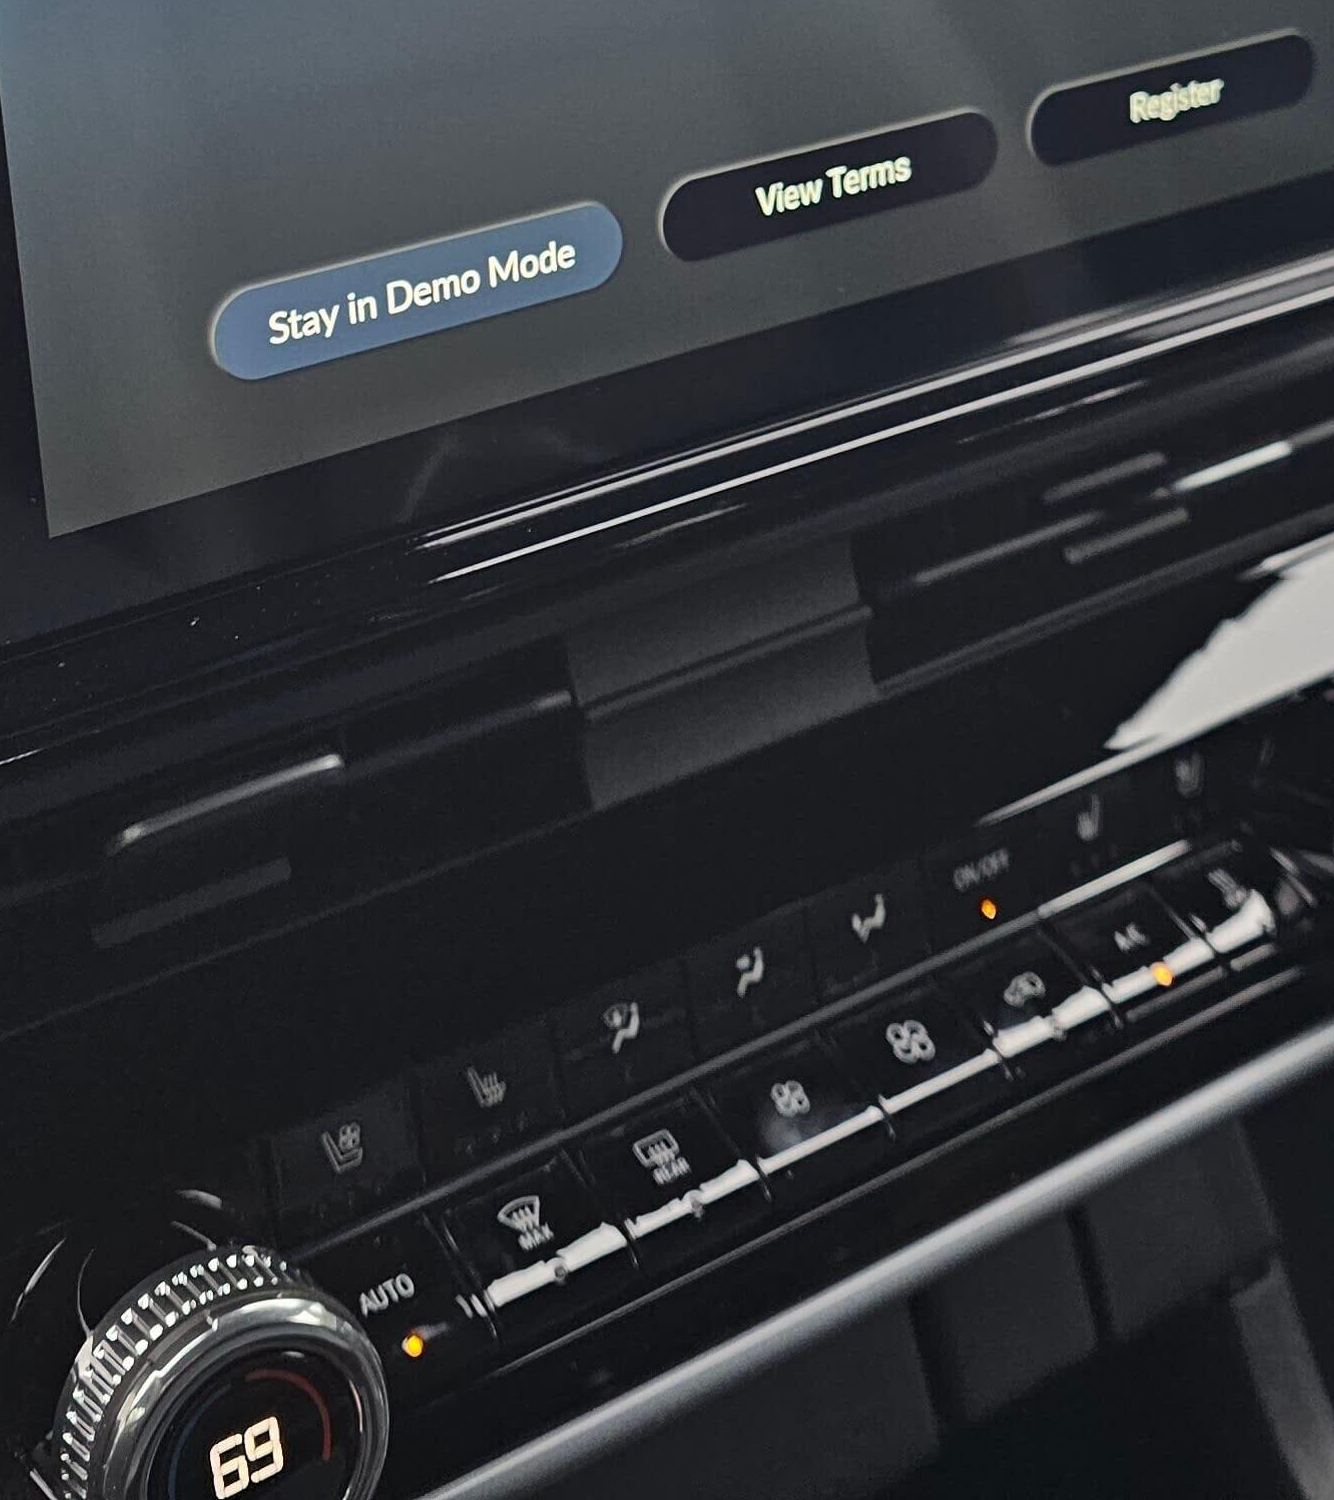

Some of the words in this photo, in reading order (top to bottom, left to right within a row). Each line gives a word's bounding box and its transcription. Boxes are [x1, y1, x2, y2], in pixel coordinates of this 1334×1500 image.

[1130, 79, 1224, 123] Register
[755, 179, 823, 215] View
[826, 157, 911, 197] Terms
[269, 304, 340, 344] Stay
[347, 292, 378, 324] in
[386, 270, 481, 314] Demo
[488, 240, 575, 288] Mode
[359, 1273, 415, 1318] AUTO
[209, 1416, 284, 1499] 69
